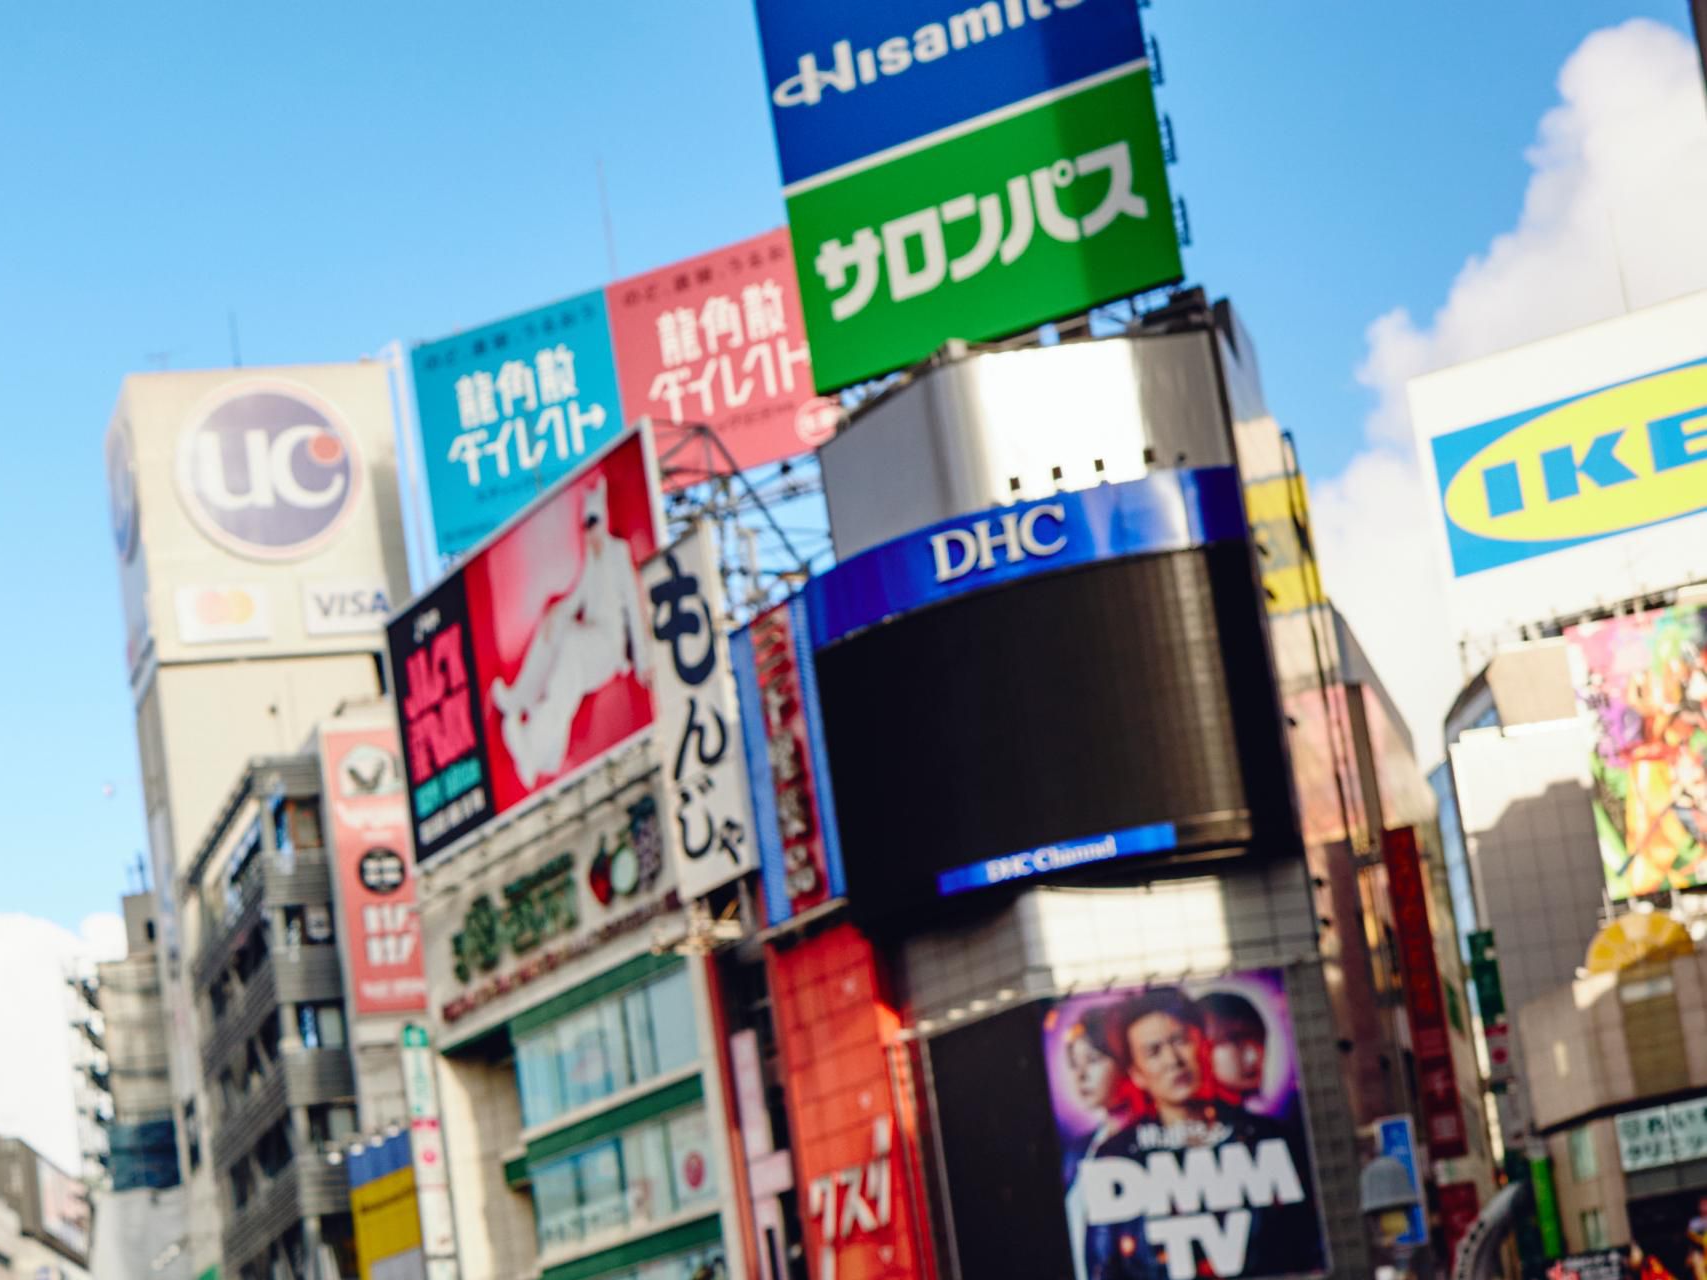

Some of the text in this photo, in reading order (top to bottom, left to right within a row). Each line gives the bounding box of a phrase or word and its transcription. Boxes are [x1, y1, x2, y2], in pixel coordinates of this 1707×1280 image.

[815, 140, 1149, 322] サロンパス
[648, 337, 812, 425] ダイレクト
[448, 401, 606, 486] ダイレクト
[930, 503, 1068, 583] DHC
[315, 590, 391, 617] VISA
[650, 549, 744, 865] もんじゃ
[986, 834, 1117, 883] DHC Channel
[1080, 1137, 1305, 1227] DMM
